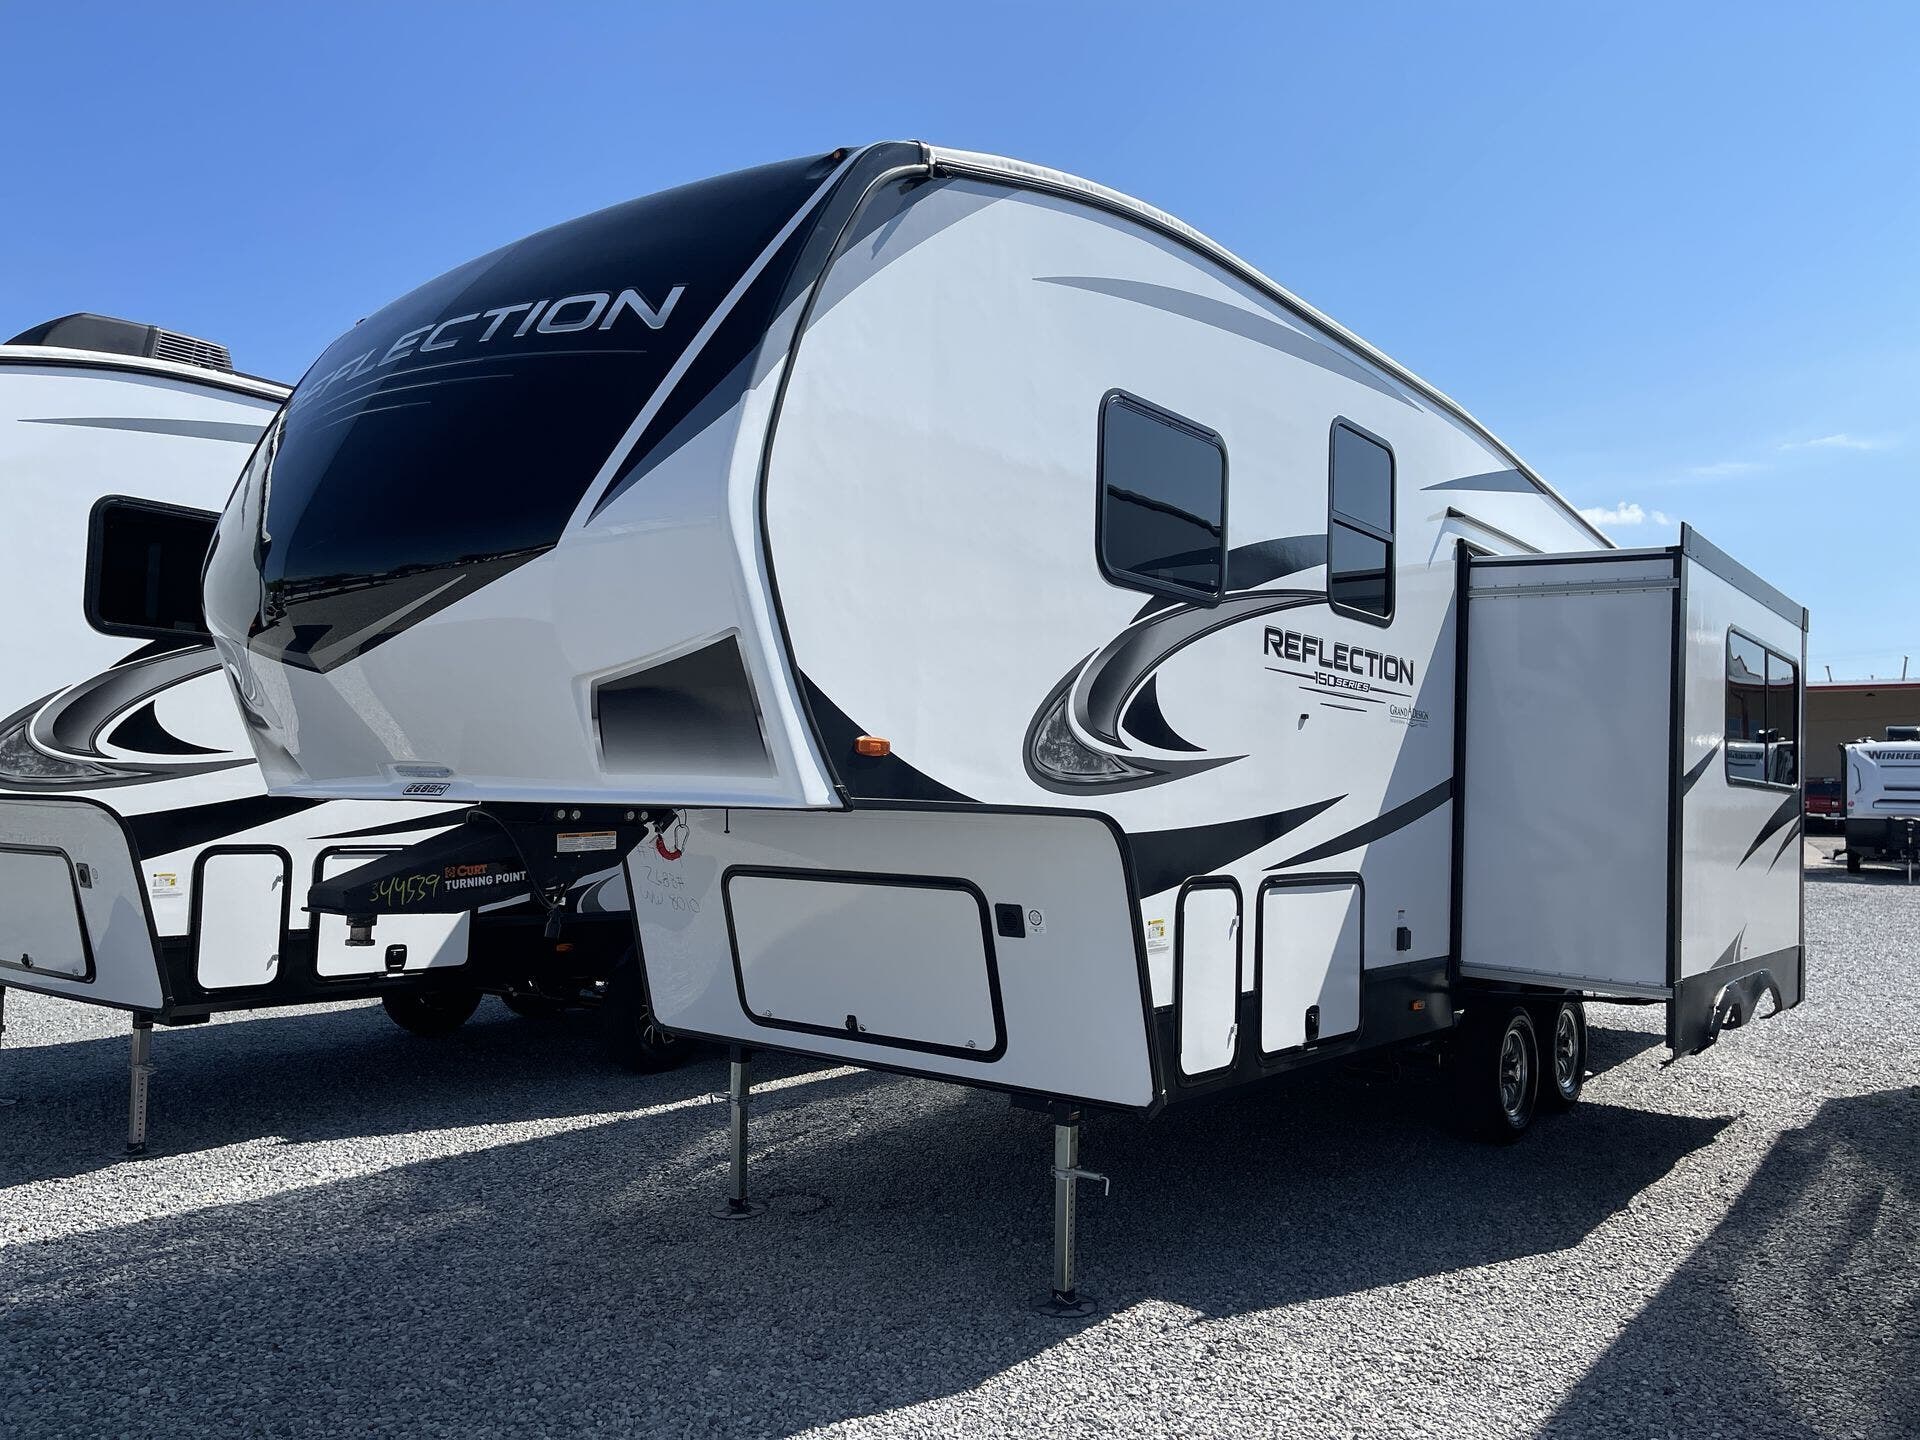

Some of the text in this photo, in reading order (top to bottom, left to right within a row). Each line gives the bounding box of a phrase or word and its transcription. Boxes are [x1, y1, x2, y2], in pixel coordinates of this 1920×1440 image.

[1264, 625, 1414, 686] REFLECTION
[1314, 671, 1370, 692] 150 SERIES
[445, 871, 527, 891] TURNING POINT
[457, 864, 487, 877] CURT
[369, 874, 441, 906] 344539
